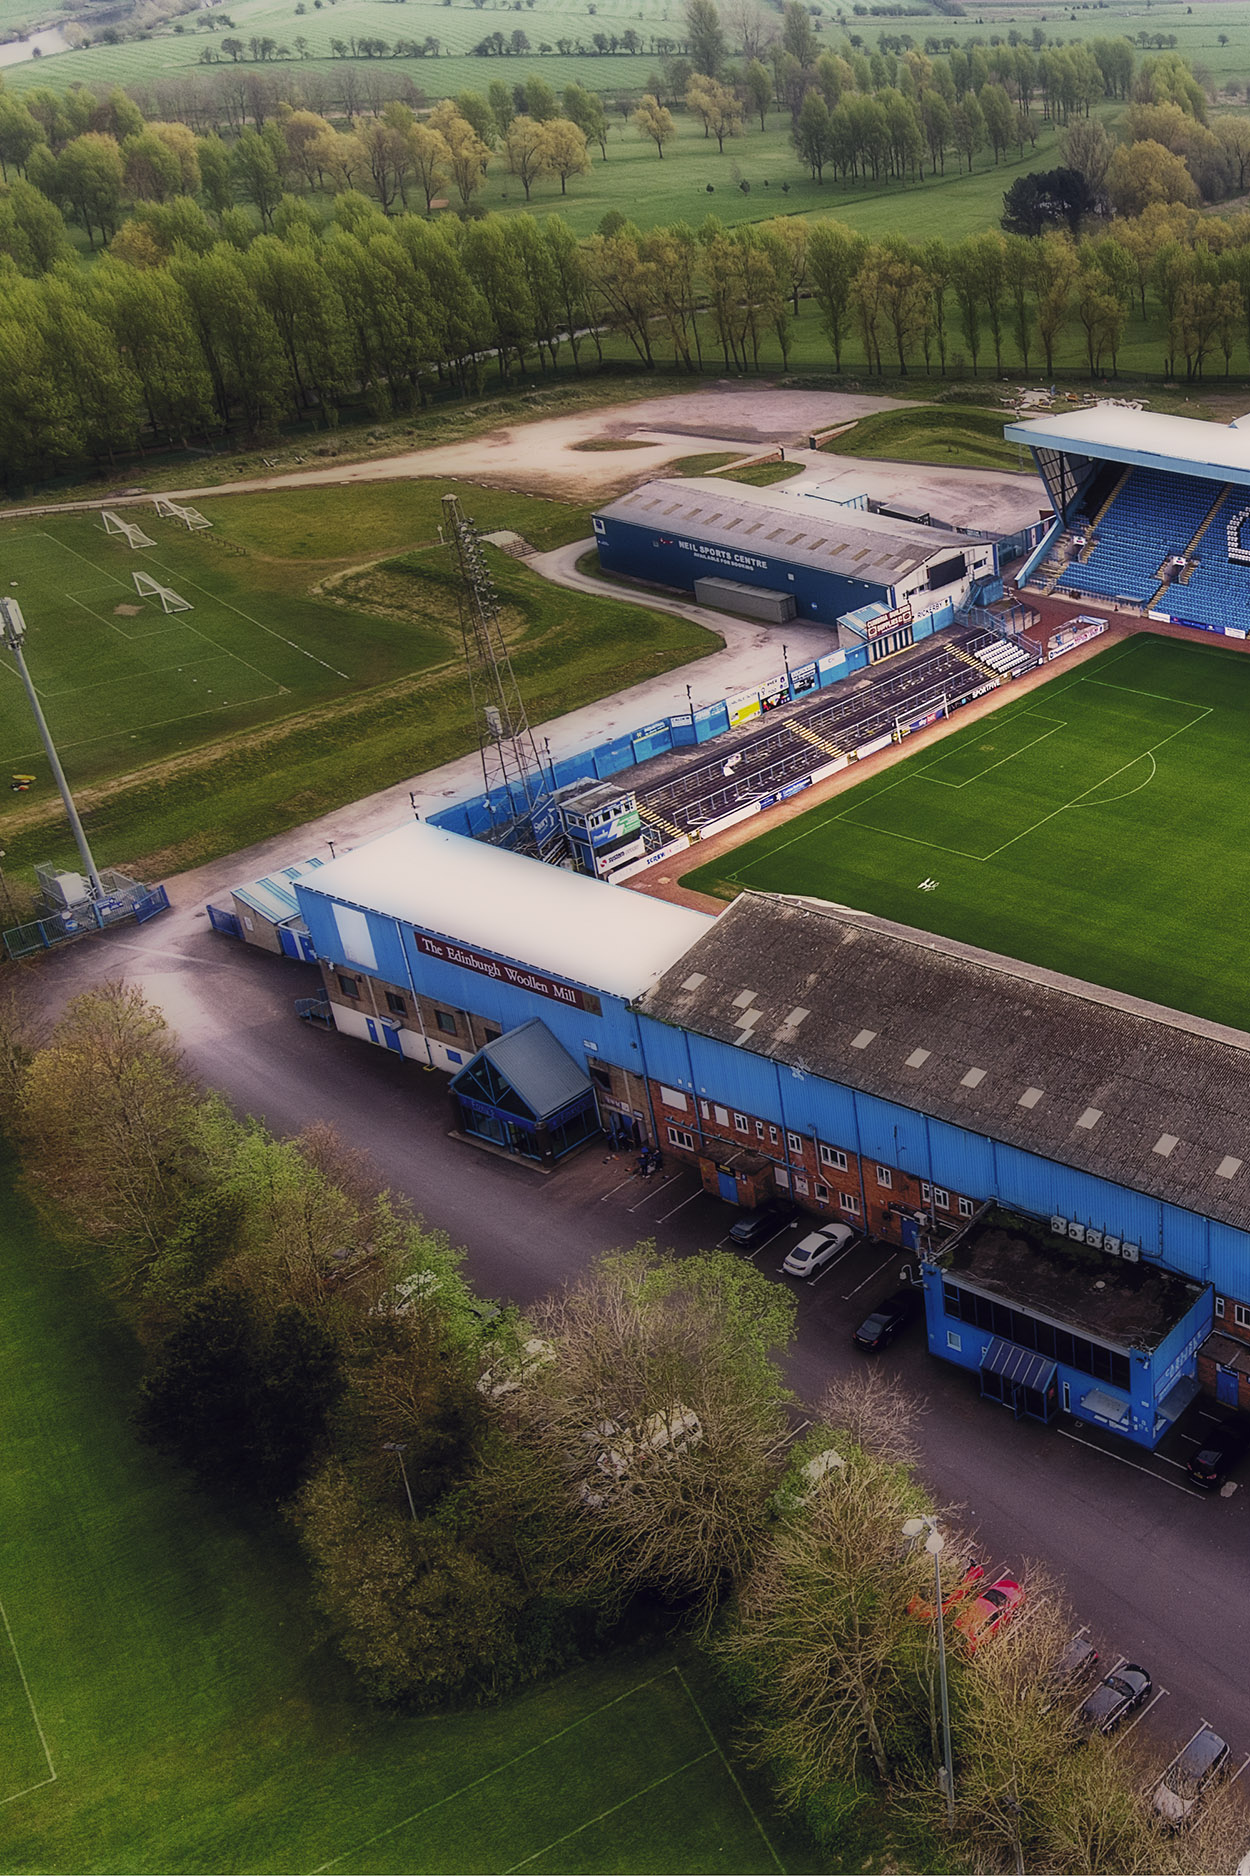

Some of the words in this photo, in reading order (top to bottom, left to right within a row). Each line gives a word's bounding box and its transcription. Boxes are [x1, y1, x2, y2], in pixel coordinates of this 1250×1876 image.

[678, 540, 698, 552] NEIL
[699, 546, 732, 560] SPORTS
[734, 554, 768, 569] CENTRE
[693, 552, 720, 563] AVAILABLE
[720, 558, 730, 566] FOR
[731, 560, 754, 571] BOOKING
[917, 602, 942, 618] RICKERBY
[971, 677, 1001, 699] SPORTFIVE
[422, 938, 443, 956] The
[446, 947, 501, 977] Edinburgh
[504, 966, 548, 994] Woollen
[552, 984, 577, 1004] Mill
